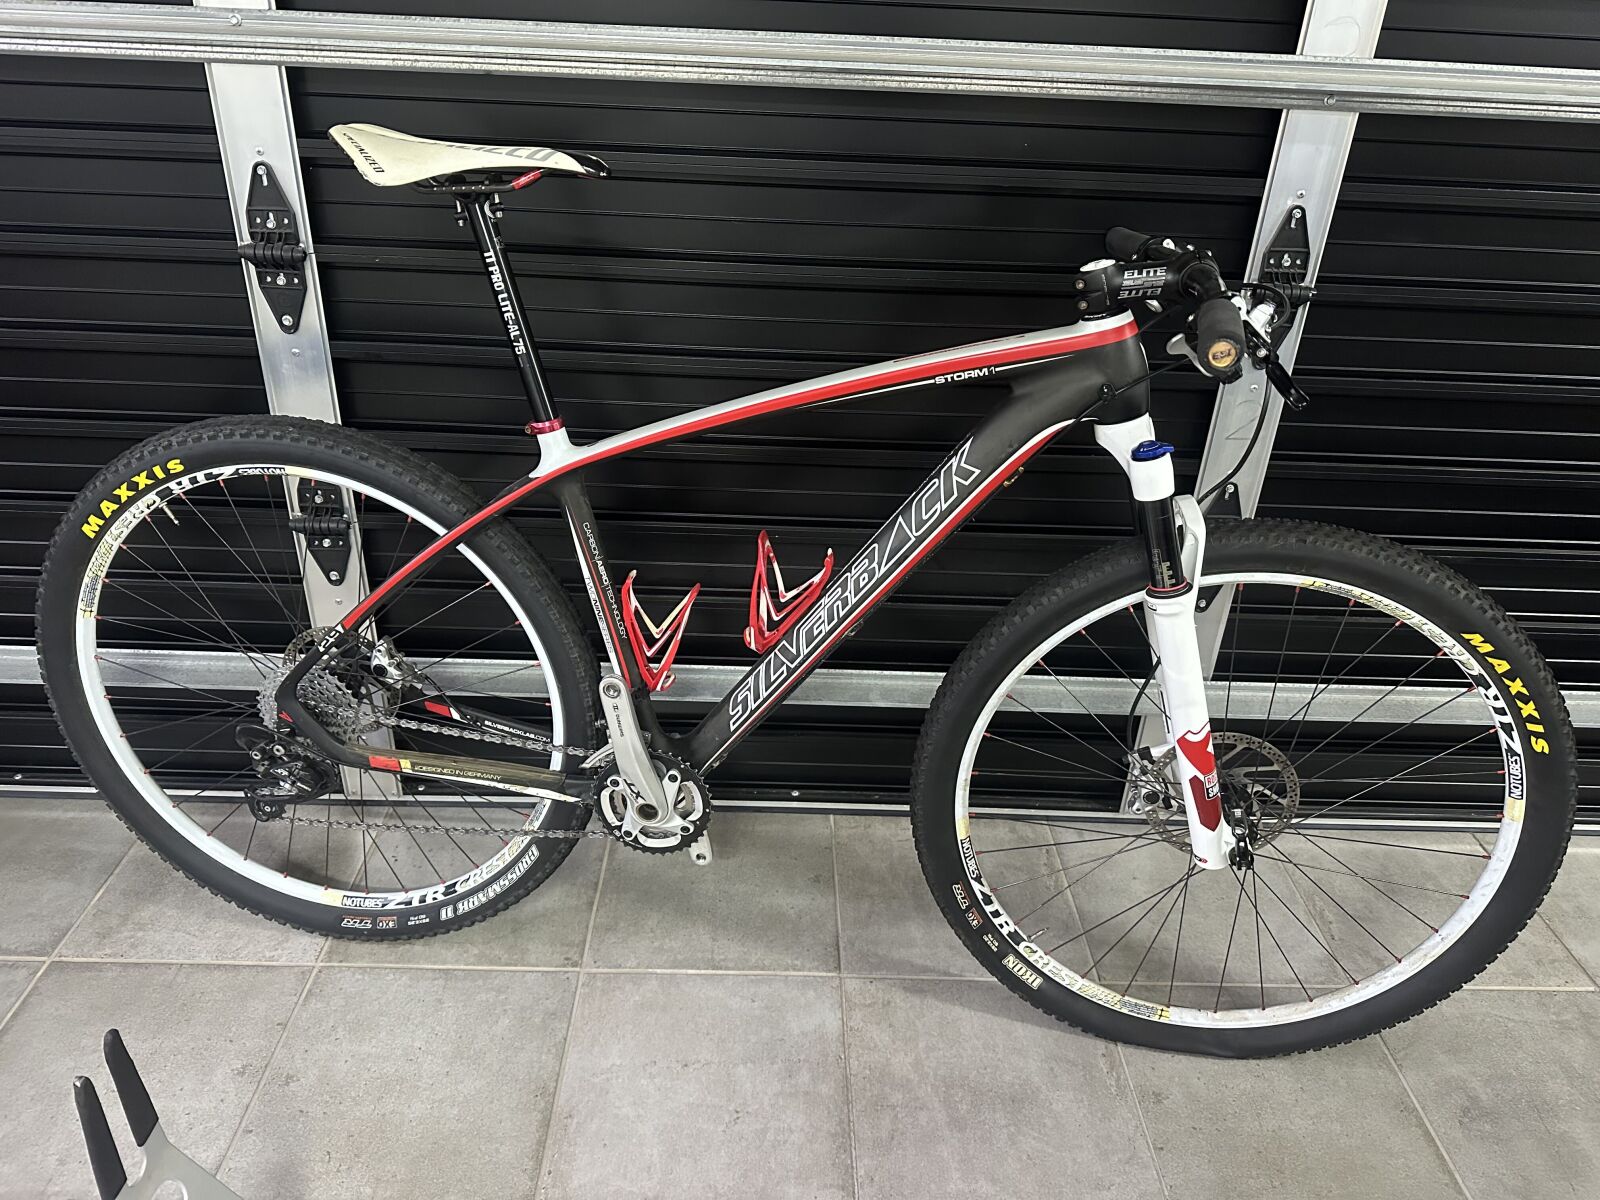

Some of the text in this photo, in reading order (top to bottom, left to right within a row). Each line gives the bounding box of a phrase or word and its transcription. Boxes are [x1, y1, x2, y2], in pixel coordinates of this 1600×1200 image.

[487, 263, 504, 291] PRO
[1124, 267, 1167, 278] ELITE
[935, 366, 996, 385] STORM 1
[81, 458, 185, 539] MAXXIS
[583, 522, 627, 639] CARBON AERO TECHNOLOGY
[728, 435, 981, 732] SILVERBACK
[1461, 633, 1549, 754] MAXXIS
[463, 770, 502, 781] GERMANY
[1510, 754, 1522, 799] NOTUBES
[961, 838, 979, 878] NOTUBES
[457, 844, 540, 915] CROSSMARK
[343, 896, 383, 908] NOTUBES
[384, 890, 446, 910] ZTR
[971, 878, 1015, 936] ZTR
[1002, 953, 1044, 989] IKON
